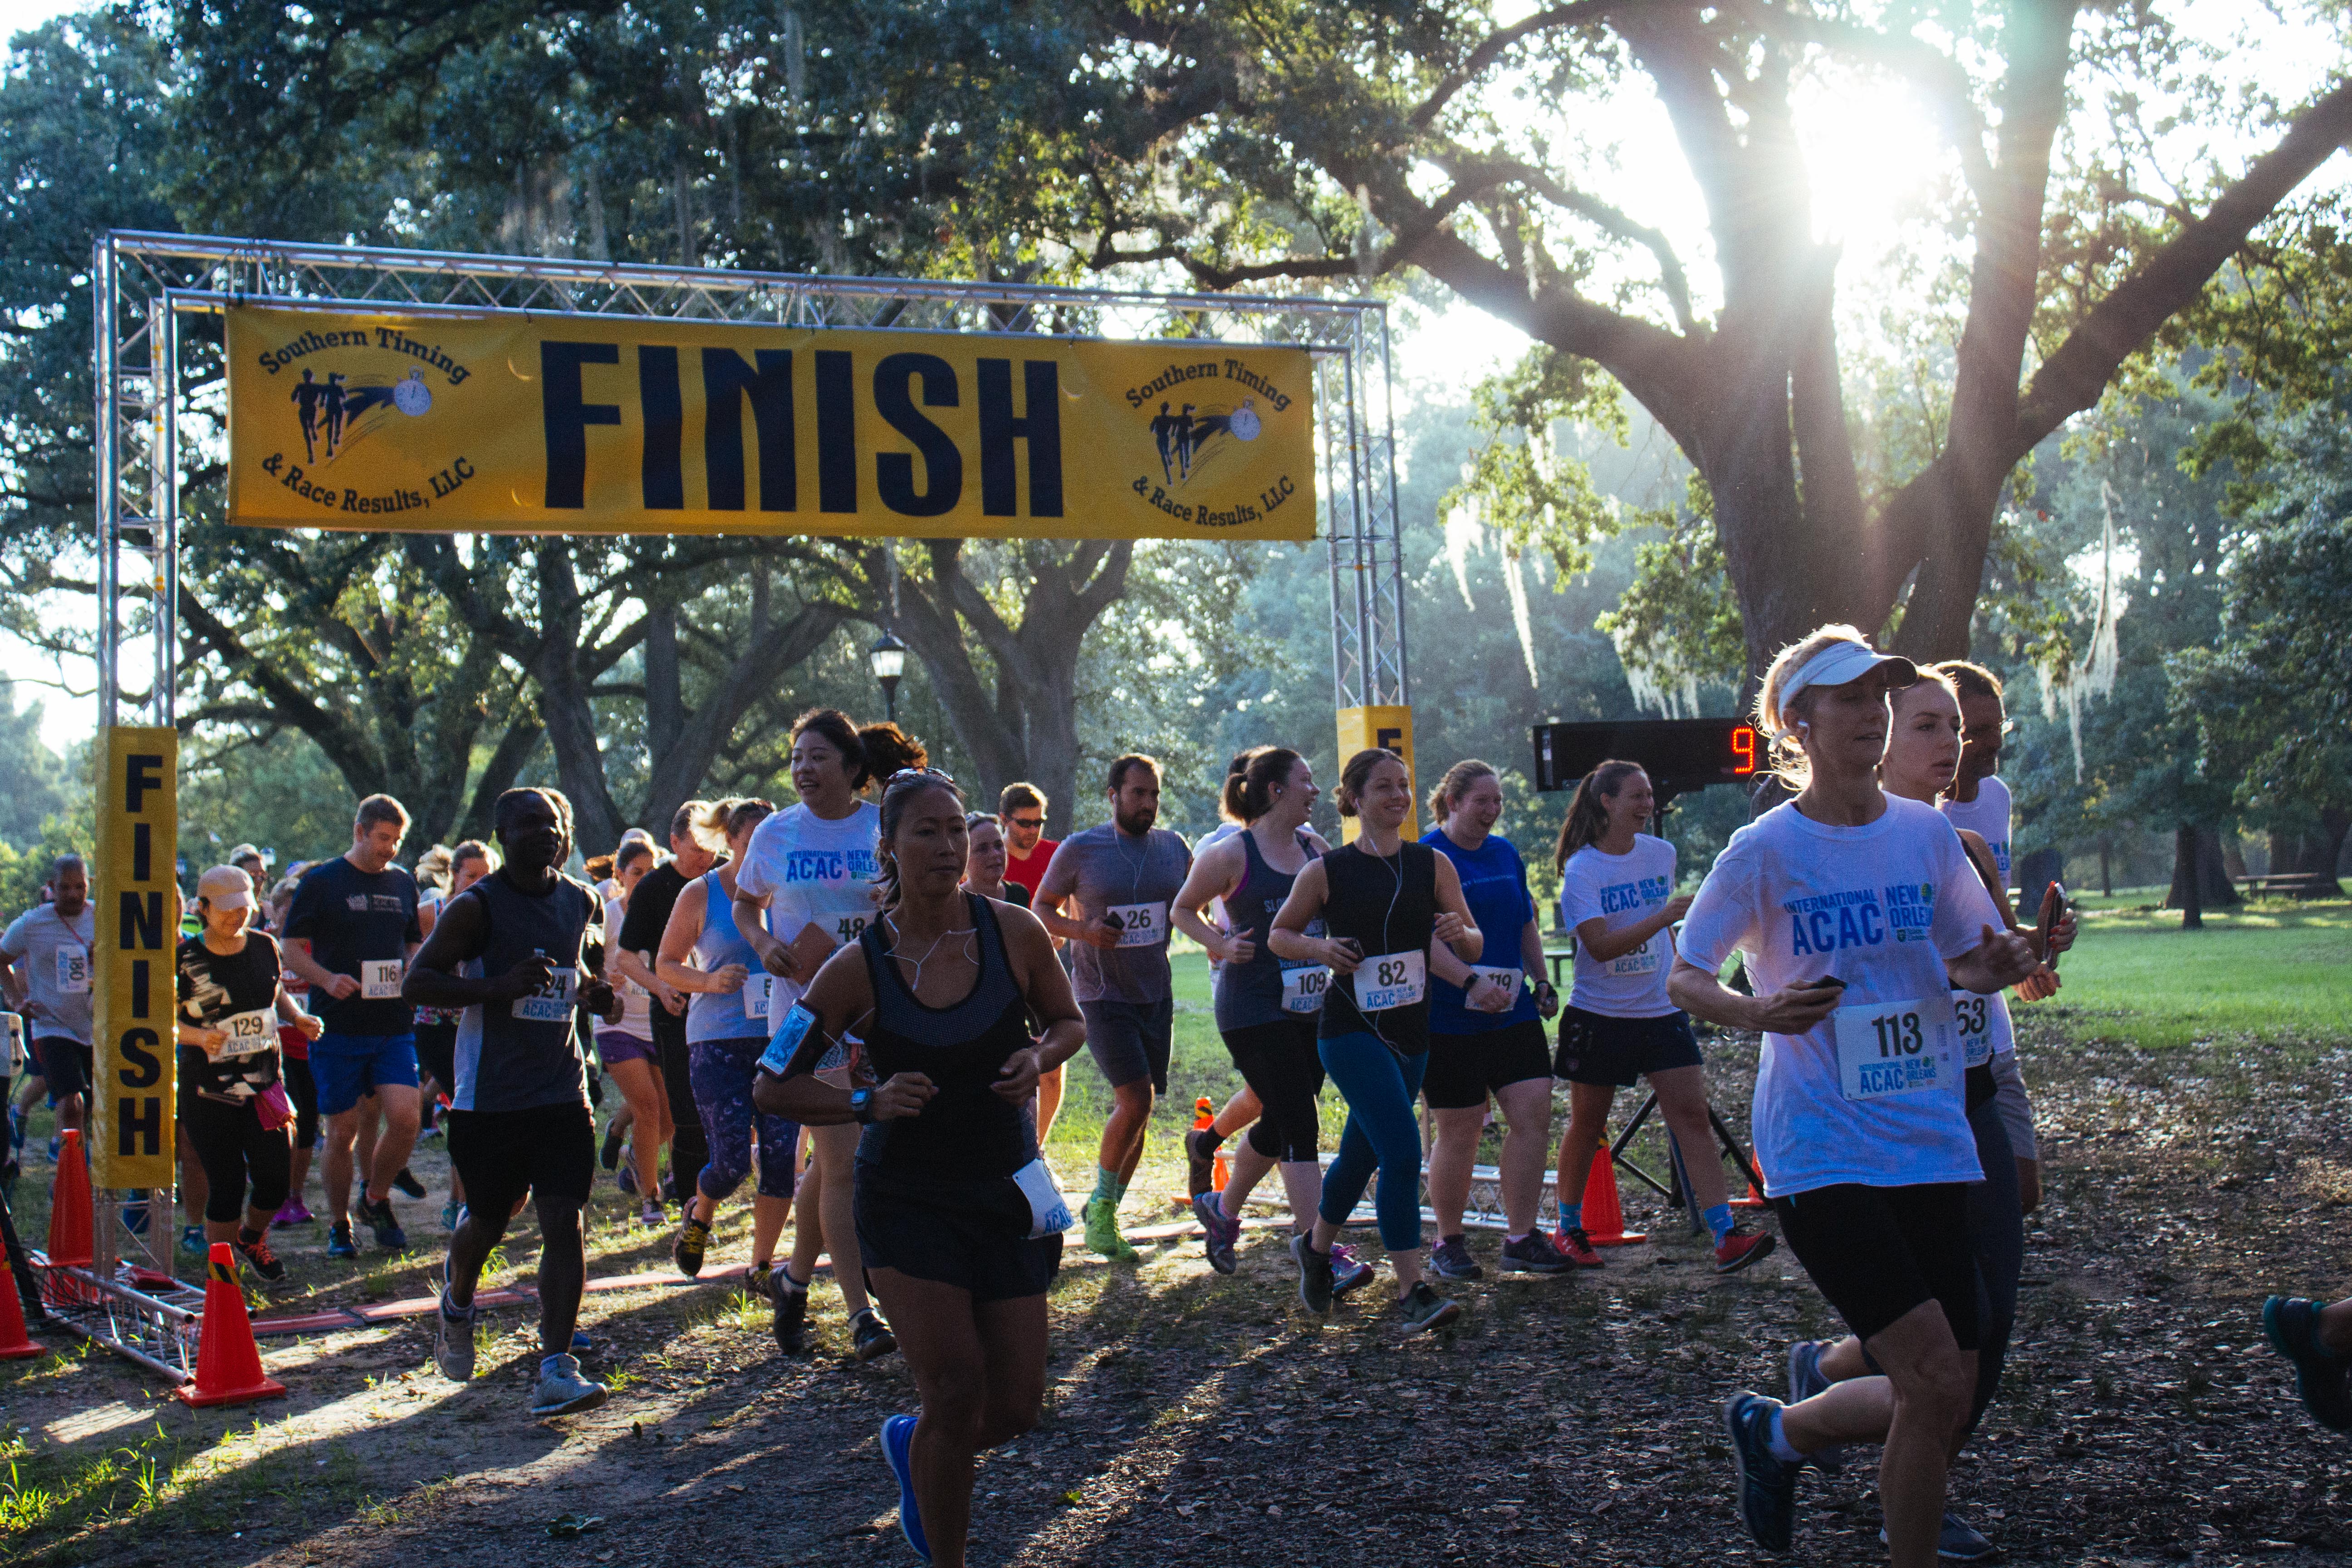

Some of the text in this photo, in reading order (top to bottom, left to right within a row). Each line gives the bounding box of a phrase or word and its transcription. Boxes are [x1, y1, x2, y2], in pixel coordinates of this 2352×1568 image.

[258, 326, 472, 386] Southern Timing
[1125, 358, 1292, 412] Southern Timing
[539, 340, 1064, 518] FINISH
[261, 453, 475, 514] & Race Results, LLC
[1132, 475, 1295, 527] & Race Results, LLC
[1732, 726, 1754, 774] 9
[786, 849, 871, 861] INTERNATIONAL NEW
[786, 857, 843, 882] ACAC
[1784, 885, 1919, 914] INTERNATIONAL NEW
[1793, 903, 1883, 956] ACAC
[69, 956, 84, 980] 180
[118, 755, 163, 1156] FINISH
[1615, 958, 1639, 973] ACAC
[378, 964, 396, 982] 116
[1298, 971, 1327, 995] 109
[1378, 960, 1408, 986] 82
[368, 985, 387, 996] ACAC
[1366, 992, 1396, 1008] ACAC
[523, 1001, 551, 1017] ACAC
[1290, 998, 1313, 1012] ACAC
[231, 1016, 263, 1037] 129
[1871, 1012, 1922, 1057] 113
[227, 1040, 250, 1053] ACAC
[1860, 1068, 1904, 1093] ACAC
